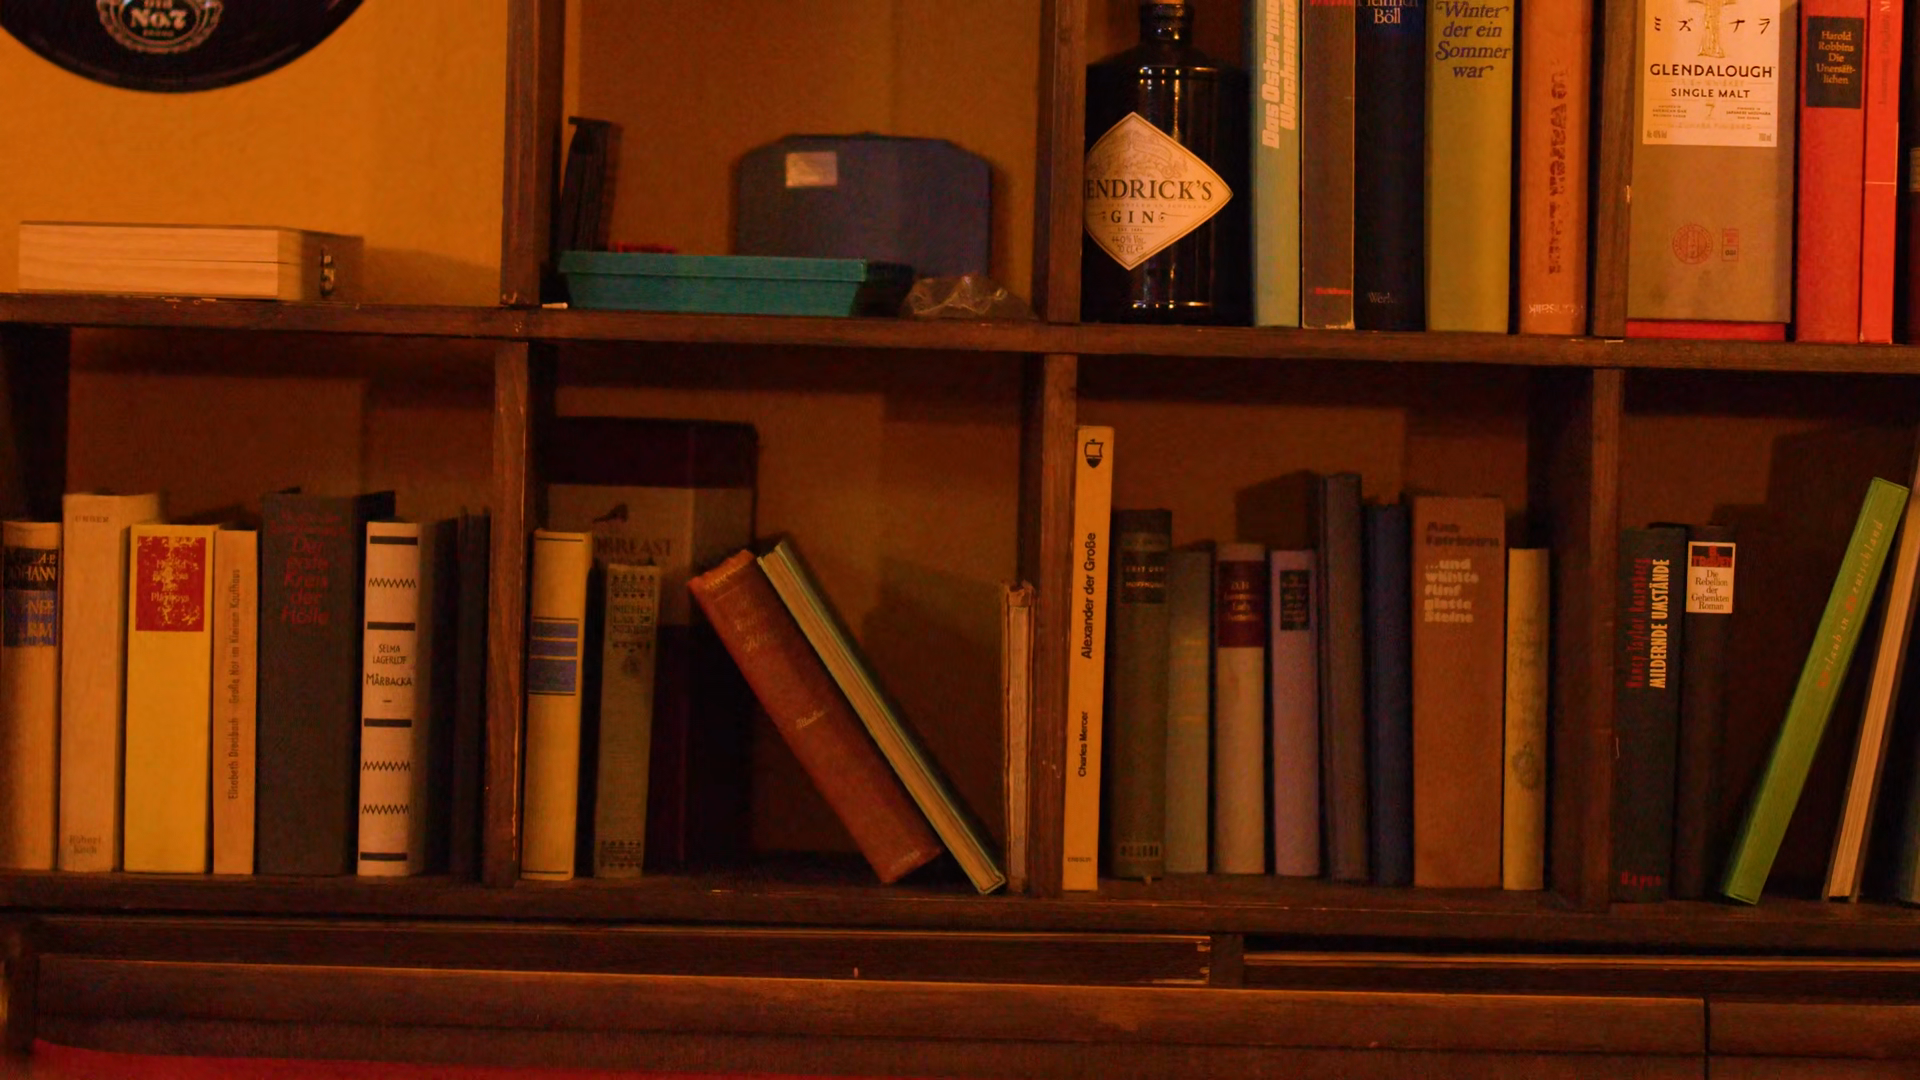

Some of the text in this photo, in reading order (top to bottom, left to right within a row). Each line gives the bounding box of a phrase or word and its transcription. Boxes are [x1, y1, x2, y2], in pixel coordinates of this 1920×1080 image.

[1374, 8, 1401, 24] Böll
[1435, 1, 1510, 18] Winter
[1443, 21, 1502, 38] der ein
[1821, 30, 1852, 41] Harold
[1435, 40, 1511, 61] Sommer
[1817, 41, 1855, 52] Robbins
[1828, 52, 1845, 62] Die
[1280, 0, 1296, 130] Wochenend
[1452, 65, 1494, 78] war
[1650, 64, 1772, 78] GLENDALOUGH
[1262, 0, 1279, 148] Das Osterma
[1823, 74, 1849, 85] lichen
[1670, 88, 1751, 98] SINGLE MALT
[1705, 103, 1715, 117] 7
[1086, 179, 1212, 201] ENDRICK'S
[1111, 210, 1154, 224] GIN
[1706, 569, 1719, 578] Die
[1694, 576, 1729, 586] Rebellion
[228, 568, 240, 609] Kaufhaus
[1705, 586, 1719, 594] der
[1080, 532, 1097, 660] Alexander der Große
[1691, 593, 1729, 603] Gehenkten
[1698, 600, 1725, 610] Roman
[1424, 611, 1474, 623] Steine
[1625, 557, 1652, 689] Nancy Taylor Rosenberg
[1649, 558, 1670, 689] MILDERNDE UMSTÄNDE
[378, 643, 401, 653] SELMA
[365, 672, 413, 687] MÅRBACKA
[1077, 711, 1088, 778] Charles Mercer
[228, 760, 239, 800] Elisabeth
